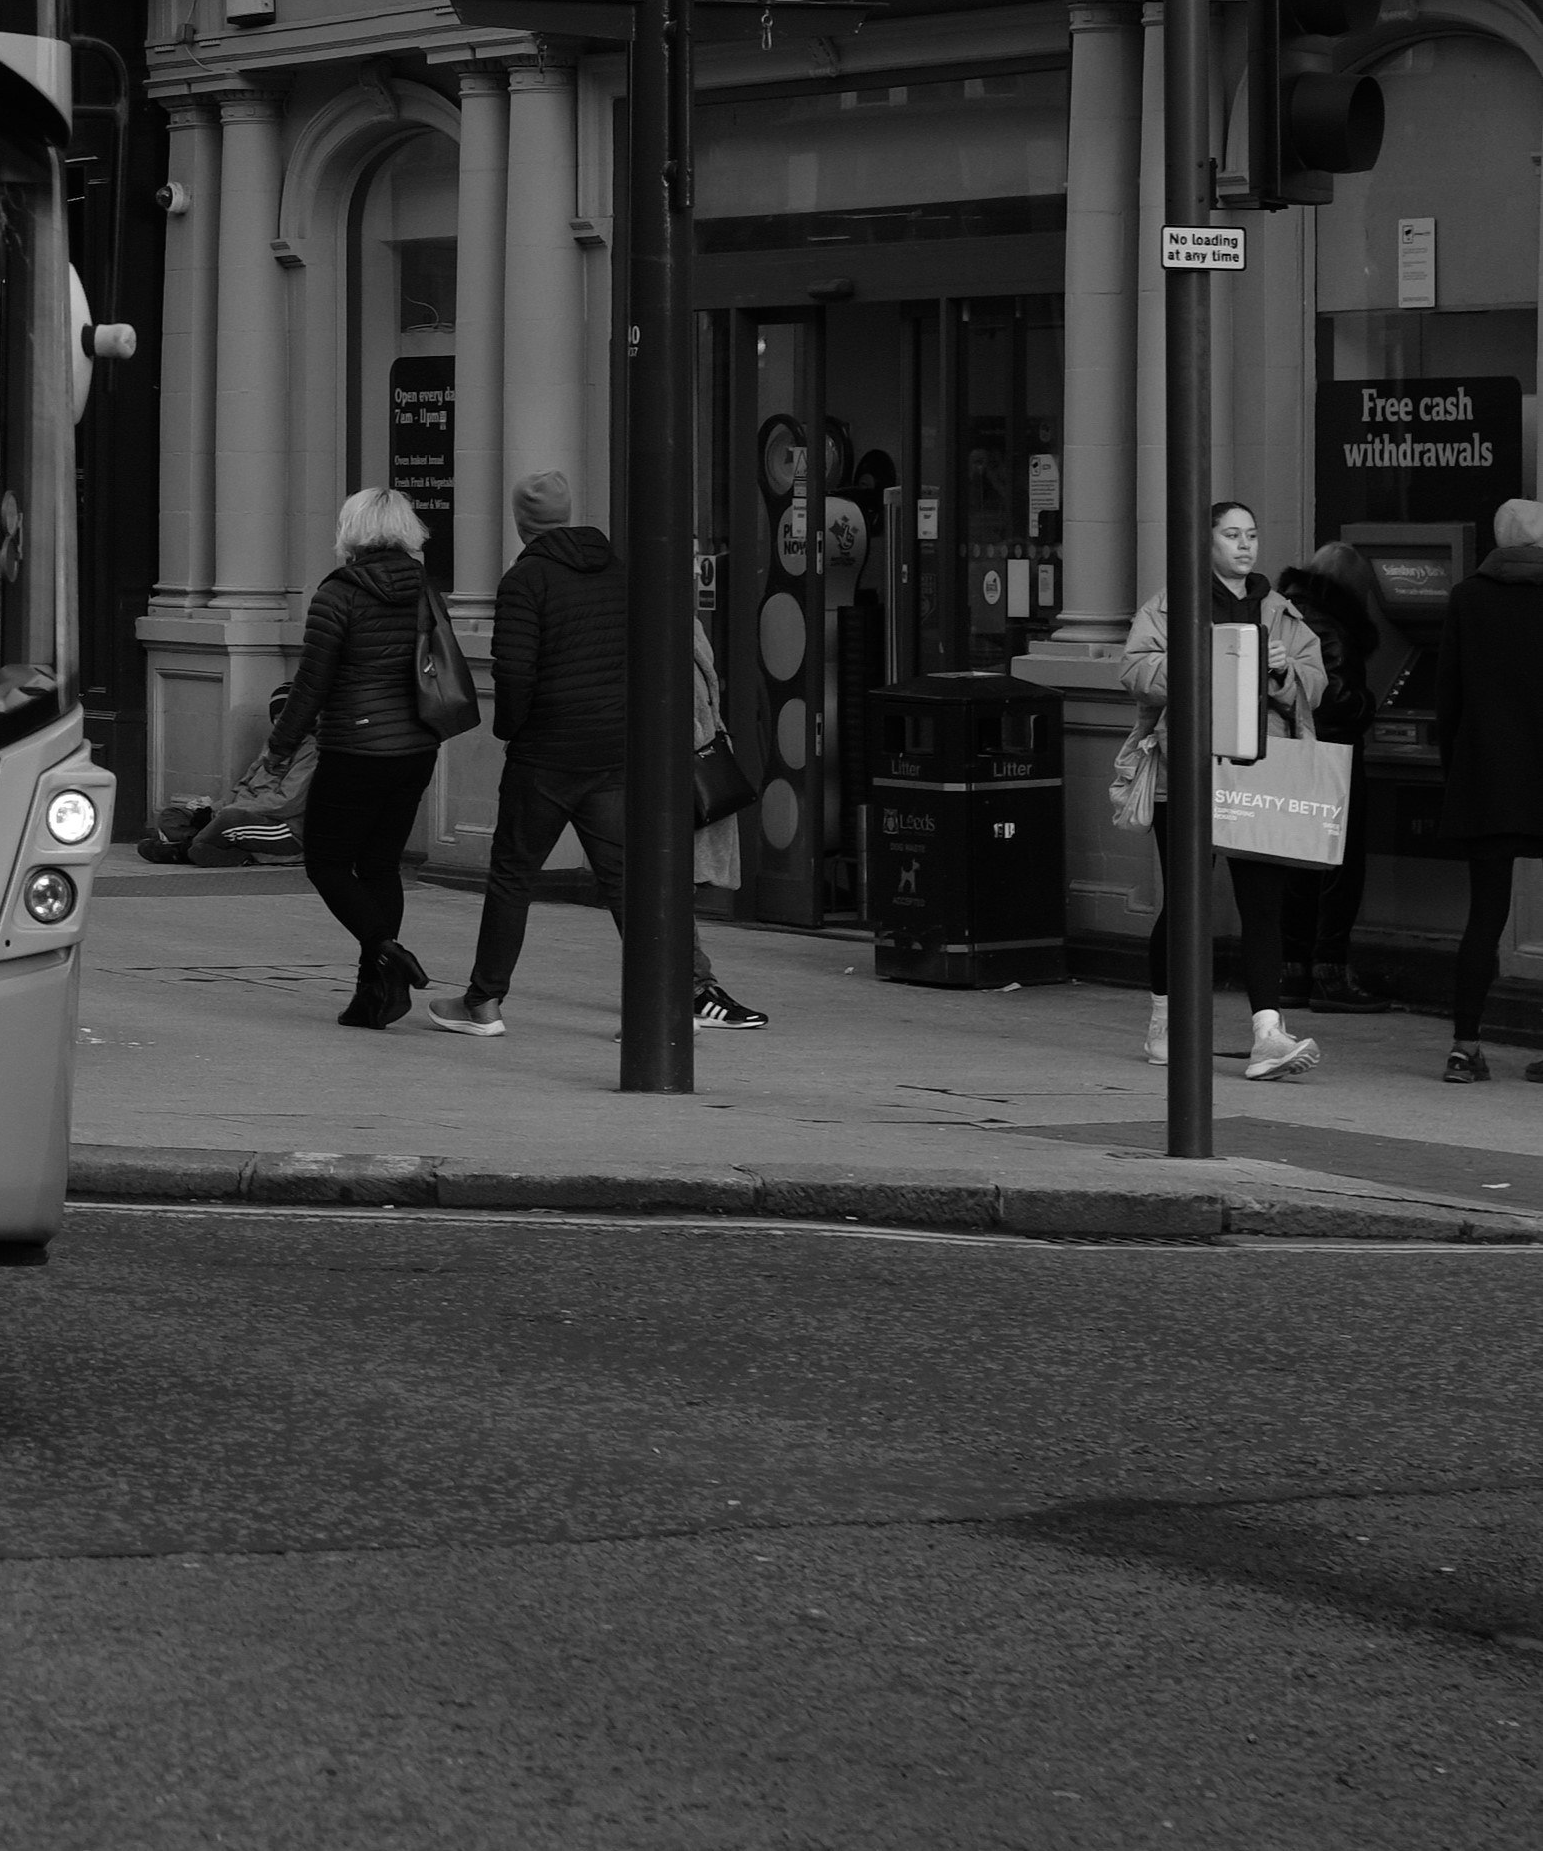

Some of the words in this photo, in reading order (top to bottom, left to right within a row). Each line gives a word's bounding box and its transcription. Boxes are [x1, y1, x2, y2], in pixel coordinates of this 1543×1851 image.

[1169, 232, 1188, 246] No
[1192, 233, 1239, 249] loading
[1167, 249, 1180, 262] at
[1185, 251, 1208, 264] any
[1212, 250, 1240, 263] time
[394, 388, 418, 407] Open
[419, 390, 443, 405] every
[444, 386, 456, 402] da
[1361, 388, 1414, 422] Free
[1419, 386, 1474, 421] cash
[394, 408, 413, 424] 7am
[1343, 432, 1494, 467] withdrawals
[891, 759, 921, 777] Litter
[993, 761, 1043, 778] Litter
[1215, 789, 1286, 812] SWEATY
[1288, 799, 1342, 820] BETTY
[899, 813, 936, 832] Leeds
